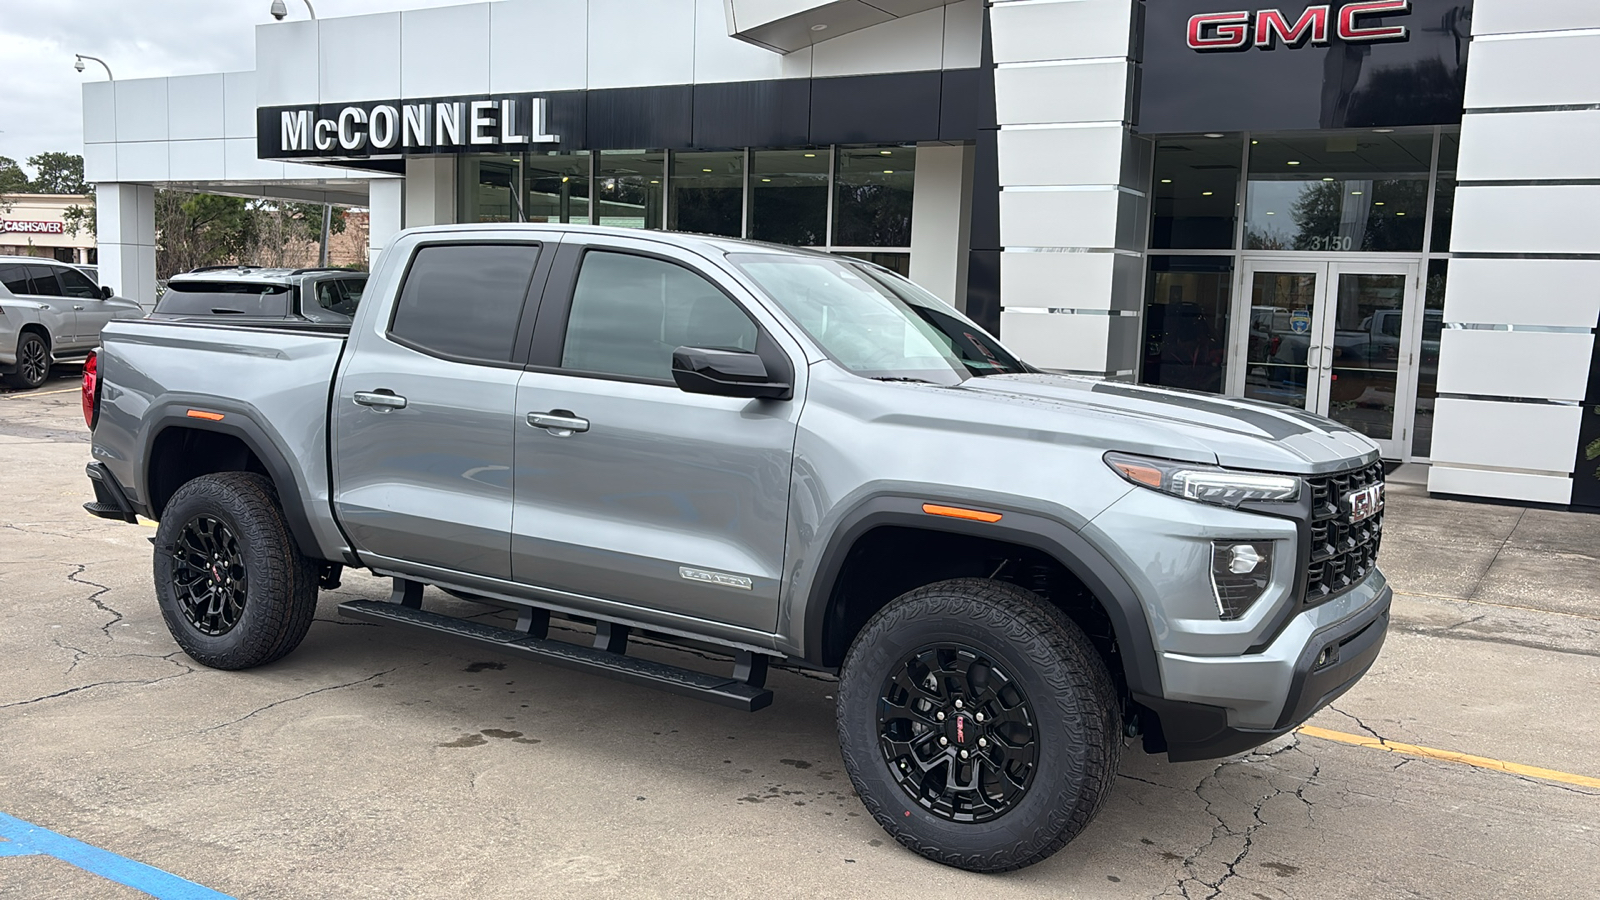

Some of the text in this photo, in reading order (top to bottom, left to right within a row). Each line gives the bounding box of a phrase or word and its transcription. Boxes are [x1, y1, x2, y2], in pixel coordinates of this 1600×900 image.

[1187, 0, 1411, 52] GMC
[4, 221, 62, 233] CASHSAVER
[1311, 235, 1352, 251] 3150
[956, 715, 965, 743] GMC
